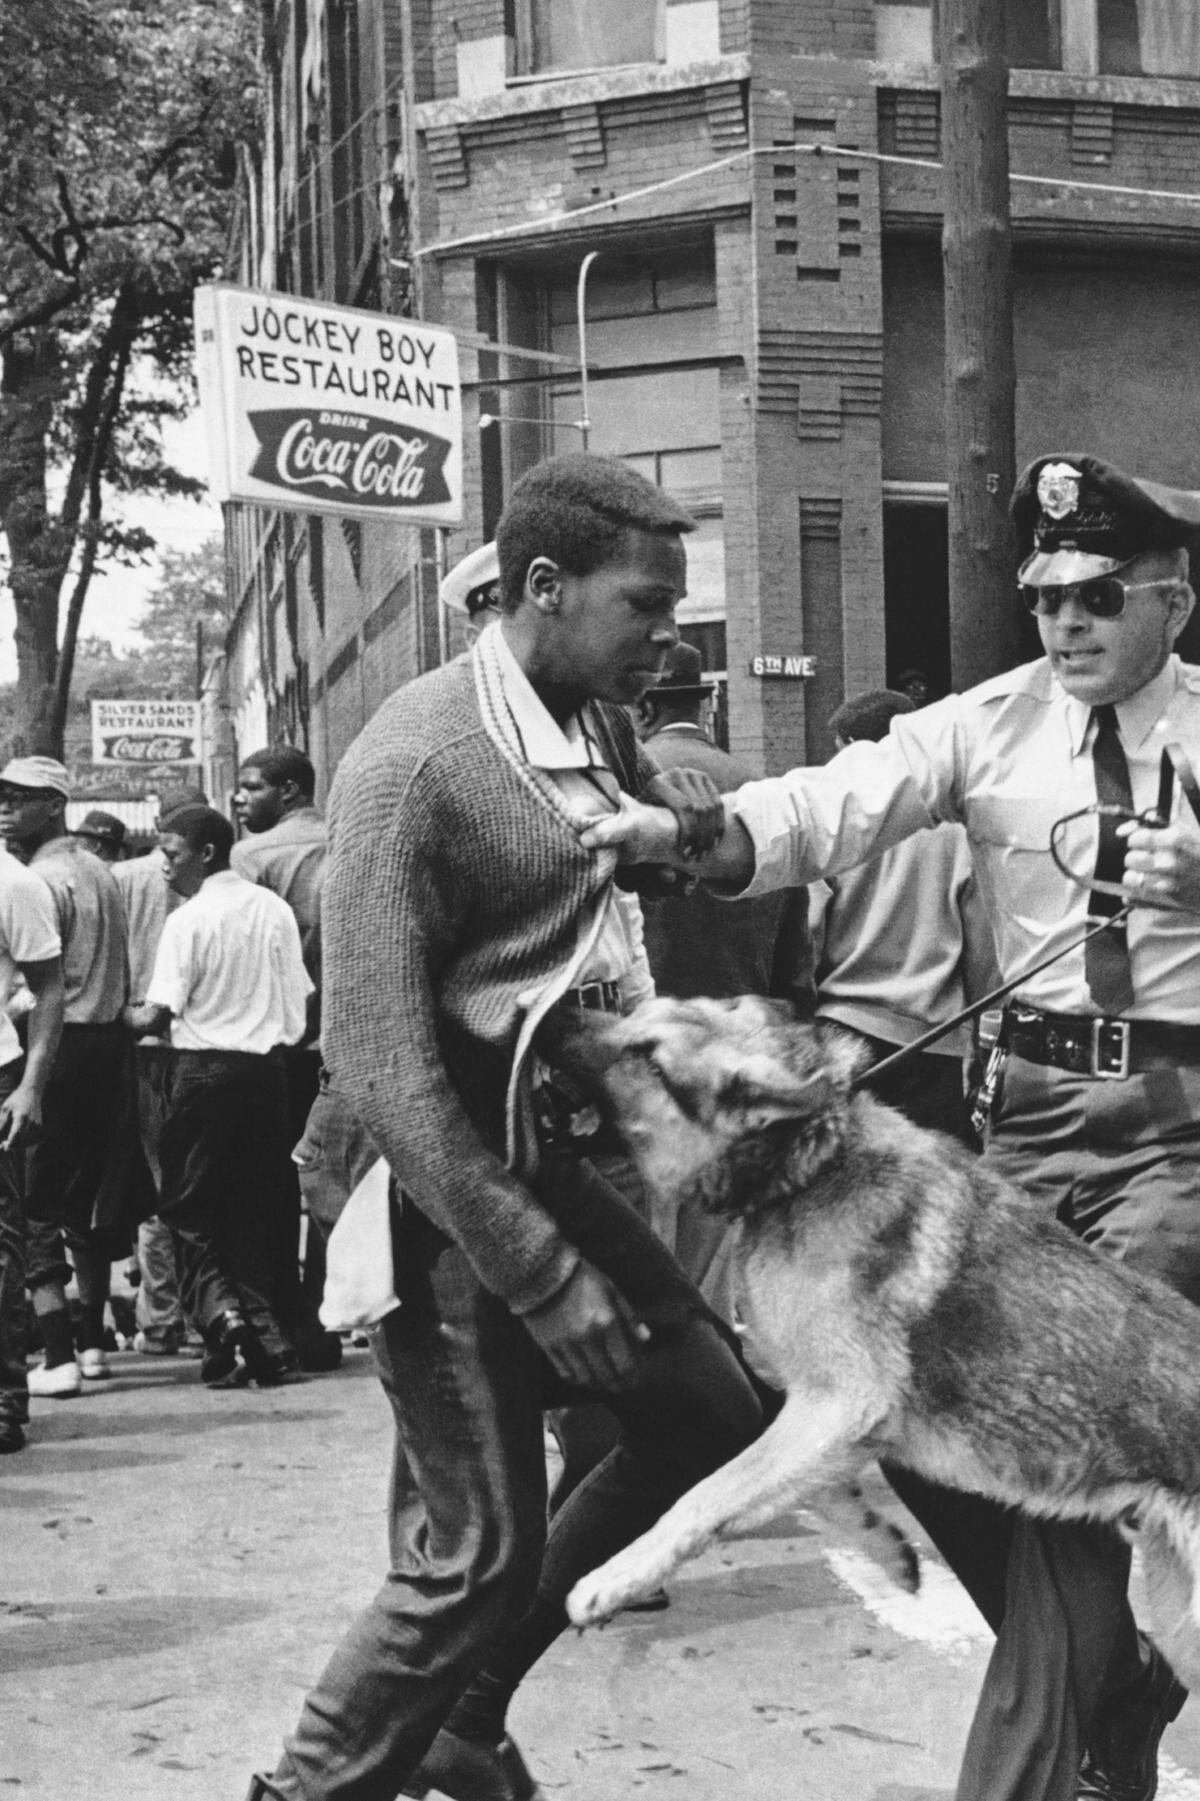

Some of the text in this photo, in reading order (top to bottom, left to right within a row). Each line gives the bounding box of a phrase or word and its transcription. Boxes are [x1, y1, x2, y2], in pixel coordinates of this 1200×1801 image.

[241, 306, 435, 369] JOCKEY BOY
[237, 345, 454, 411] RESTAURANT
[318, 411, 370, 431] DRINK
[276, 418, 429, 499] Coca-Cola
[753, 656, 782, 675] 6TH
[150, 705, 196, 715] SANDS
[99, 717, 194, 728] RESTAURANT
